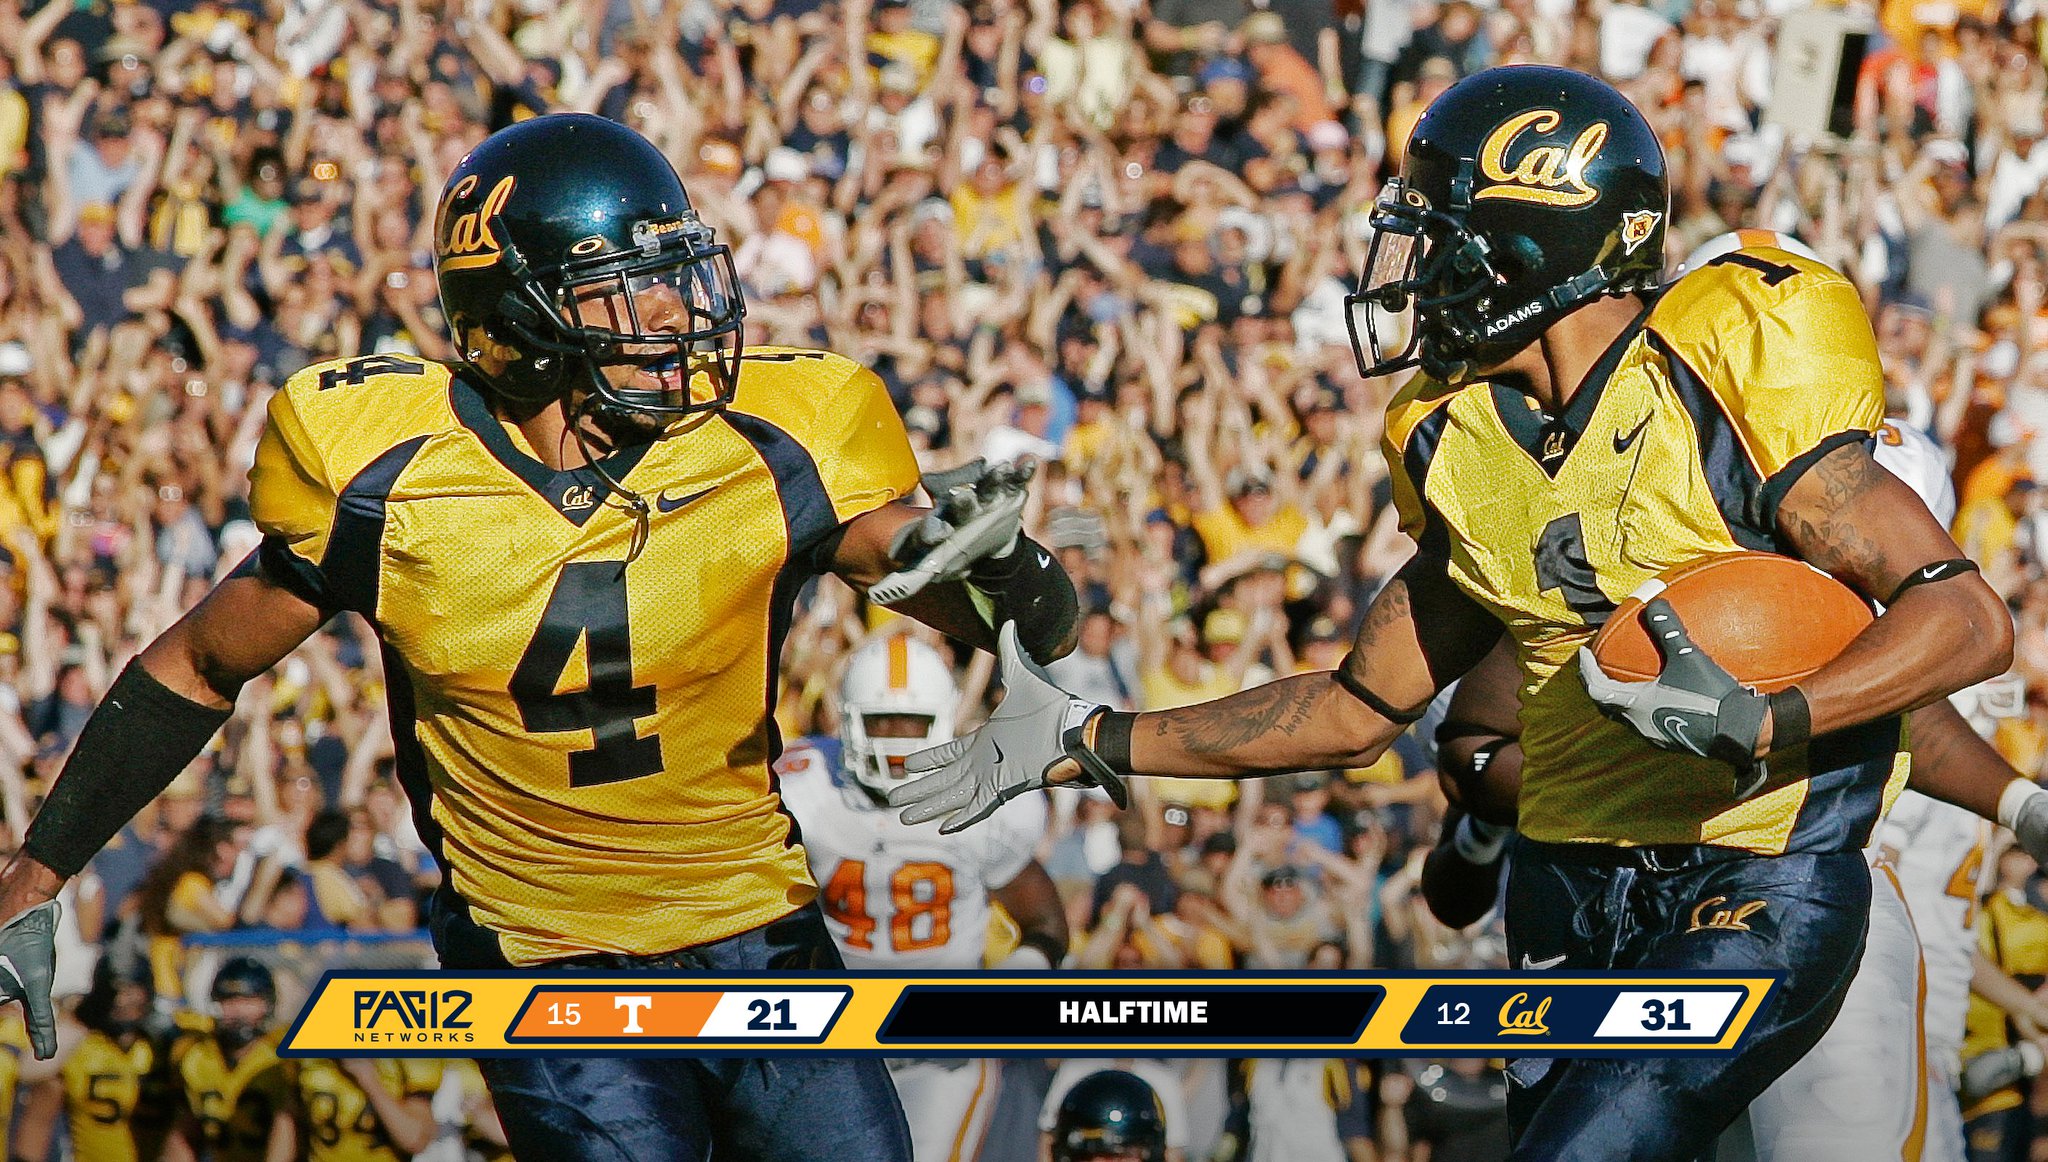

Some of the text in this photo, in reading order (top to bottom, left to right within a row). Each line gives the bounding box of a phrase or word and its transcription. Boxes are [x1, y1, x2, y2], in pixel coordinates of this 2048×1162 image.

[1473, 107, 1609, 209] Cal
[434, 173, 517, 273] Cal
[1708, 252, 1803, 288] 1
[1486, 301, 1544, 338] ADAMS
[318, 355, 425, 391] 4
[1541, 431, 1566, 463] Cal
[561, 484, 594, 512] Cal
[508, 560, 665, 788] 4
[823, 857, 955, 952] 48
[1684, 894, 1768, 934] Cal
